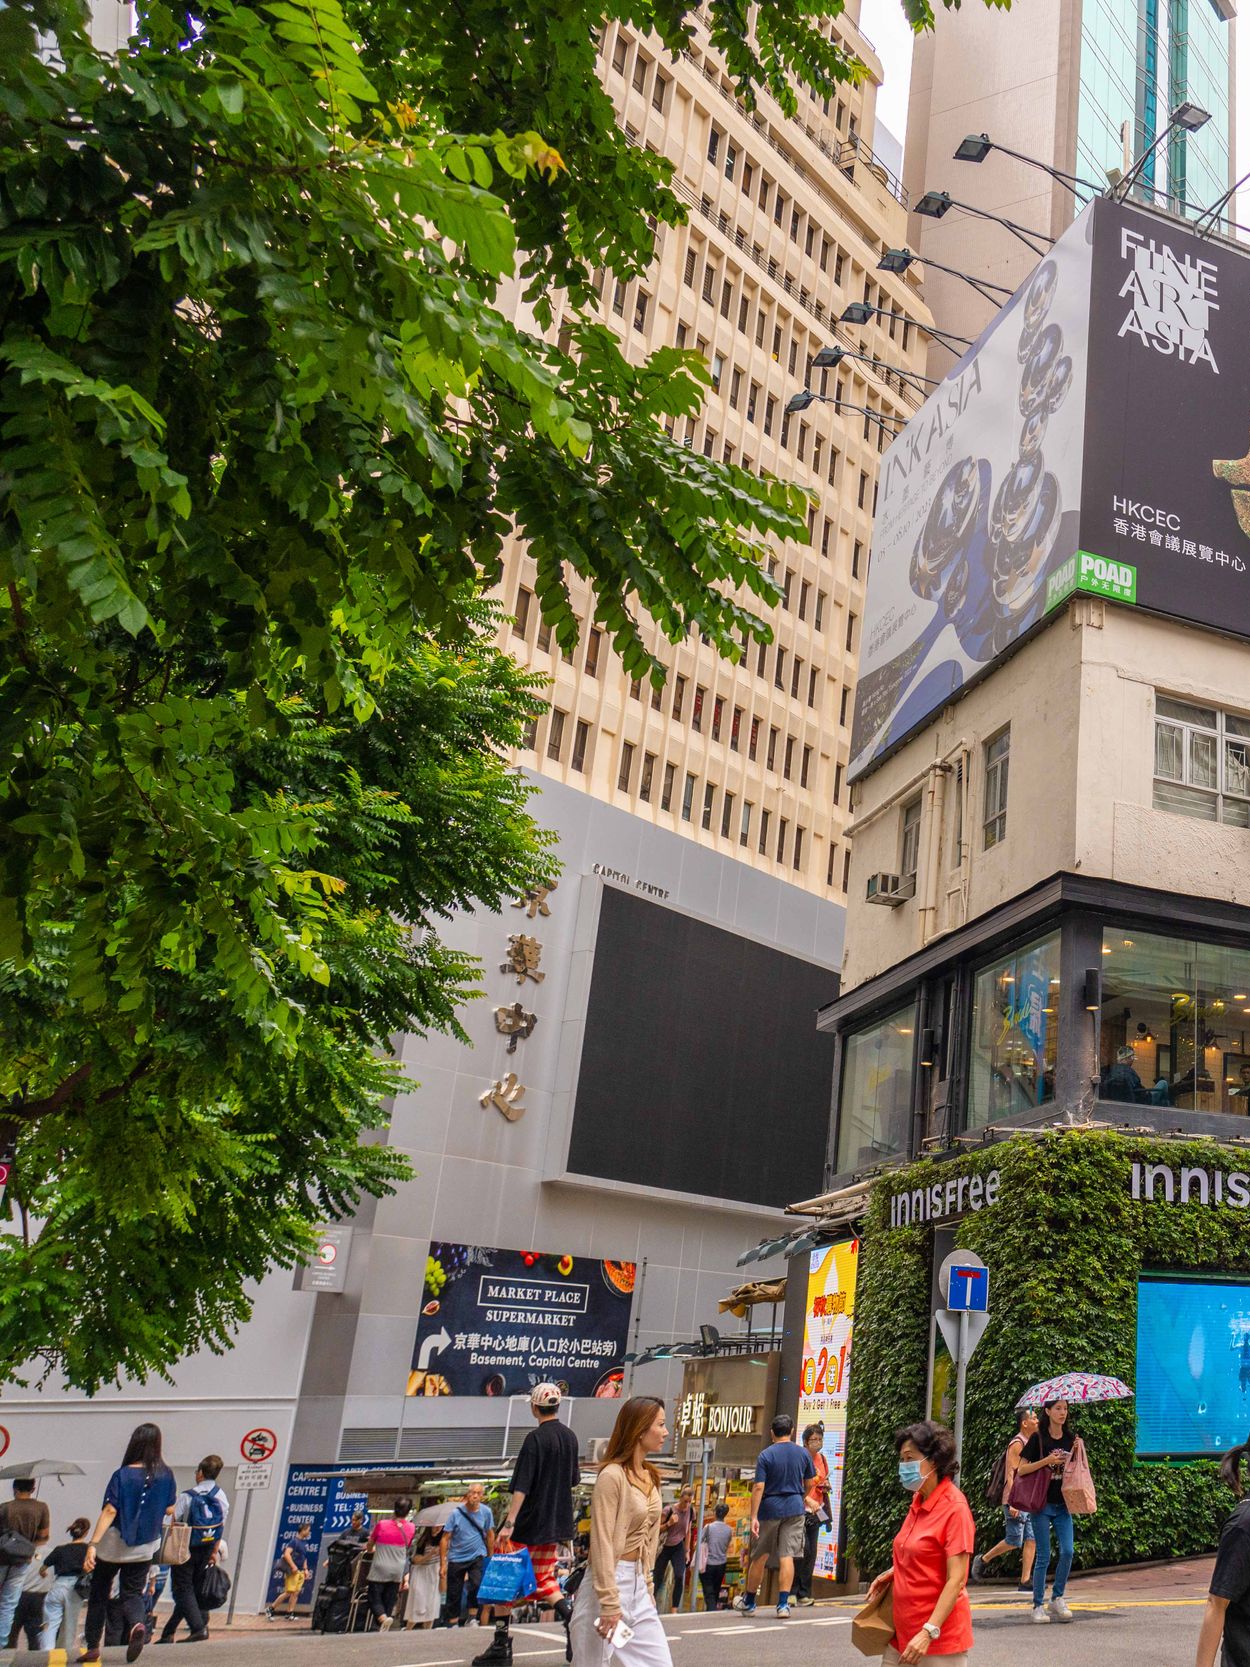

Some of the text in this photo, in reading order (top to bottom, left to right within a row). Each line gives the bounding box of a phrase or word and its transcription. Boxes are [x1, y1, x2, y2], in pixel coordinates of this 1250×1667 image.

[1121, 227, 1218, 296] FINE
[1118, 269, 1220, 331] ART
[1117, 309, 1220, 374] ASIA
[1113, 495, 1181, 531] HKCEC
[1113, 517, 1247, 573] 香港會議展覽中心
[1081, 554, 1133, 587] POAD
[487, 1285, 582, 1304] MARKET PLACE
[486, 1310, 577, 1327] SUPERMARKET
[453, 1332, 617, 1357] 京華中心地庫(入口於小巴站旁)
[470, 1353, 600, 1370] Basement, Capitol Centre
[708, 1406, 753, 1438] BONJOUR
[288, 1486, 320, 1497] CENTRE
[288, 1515, 315, 1524] CENTER
[334, 1503, 352, 1512] TEL:
